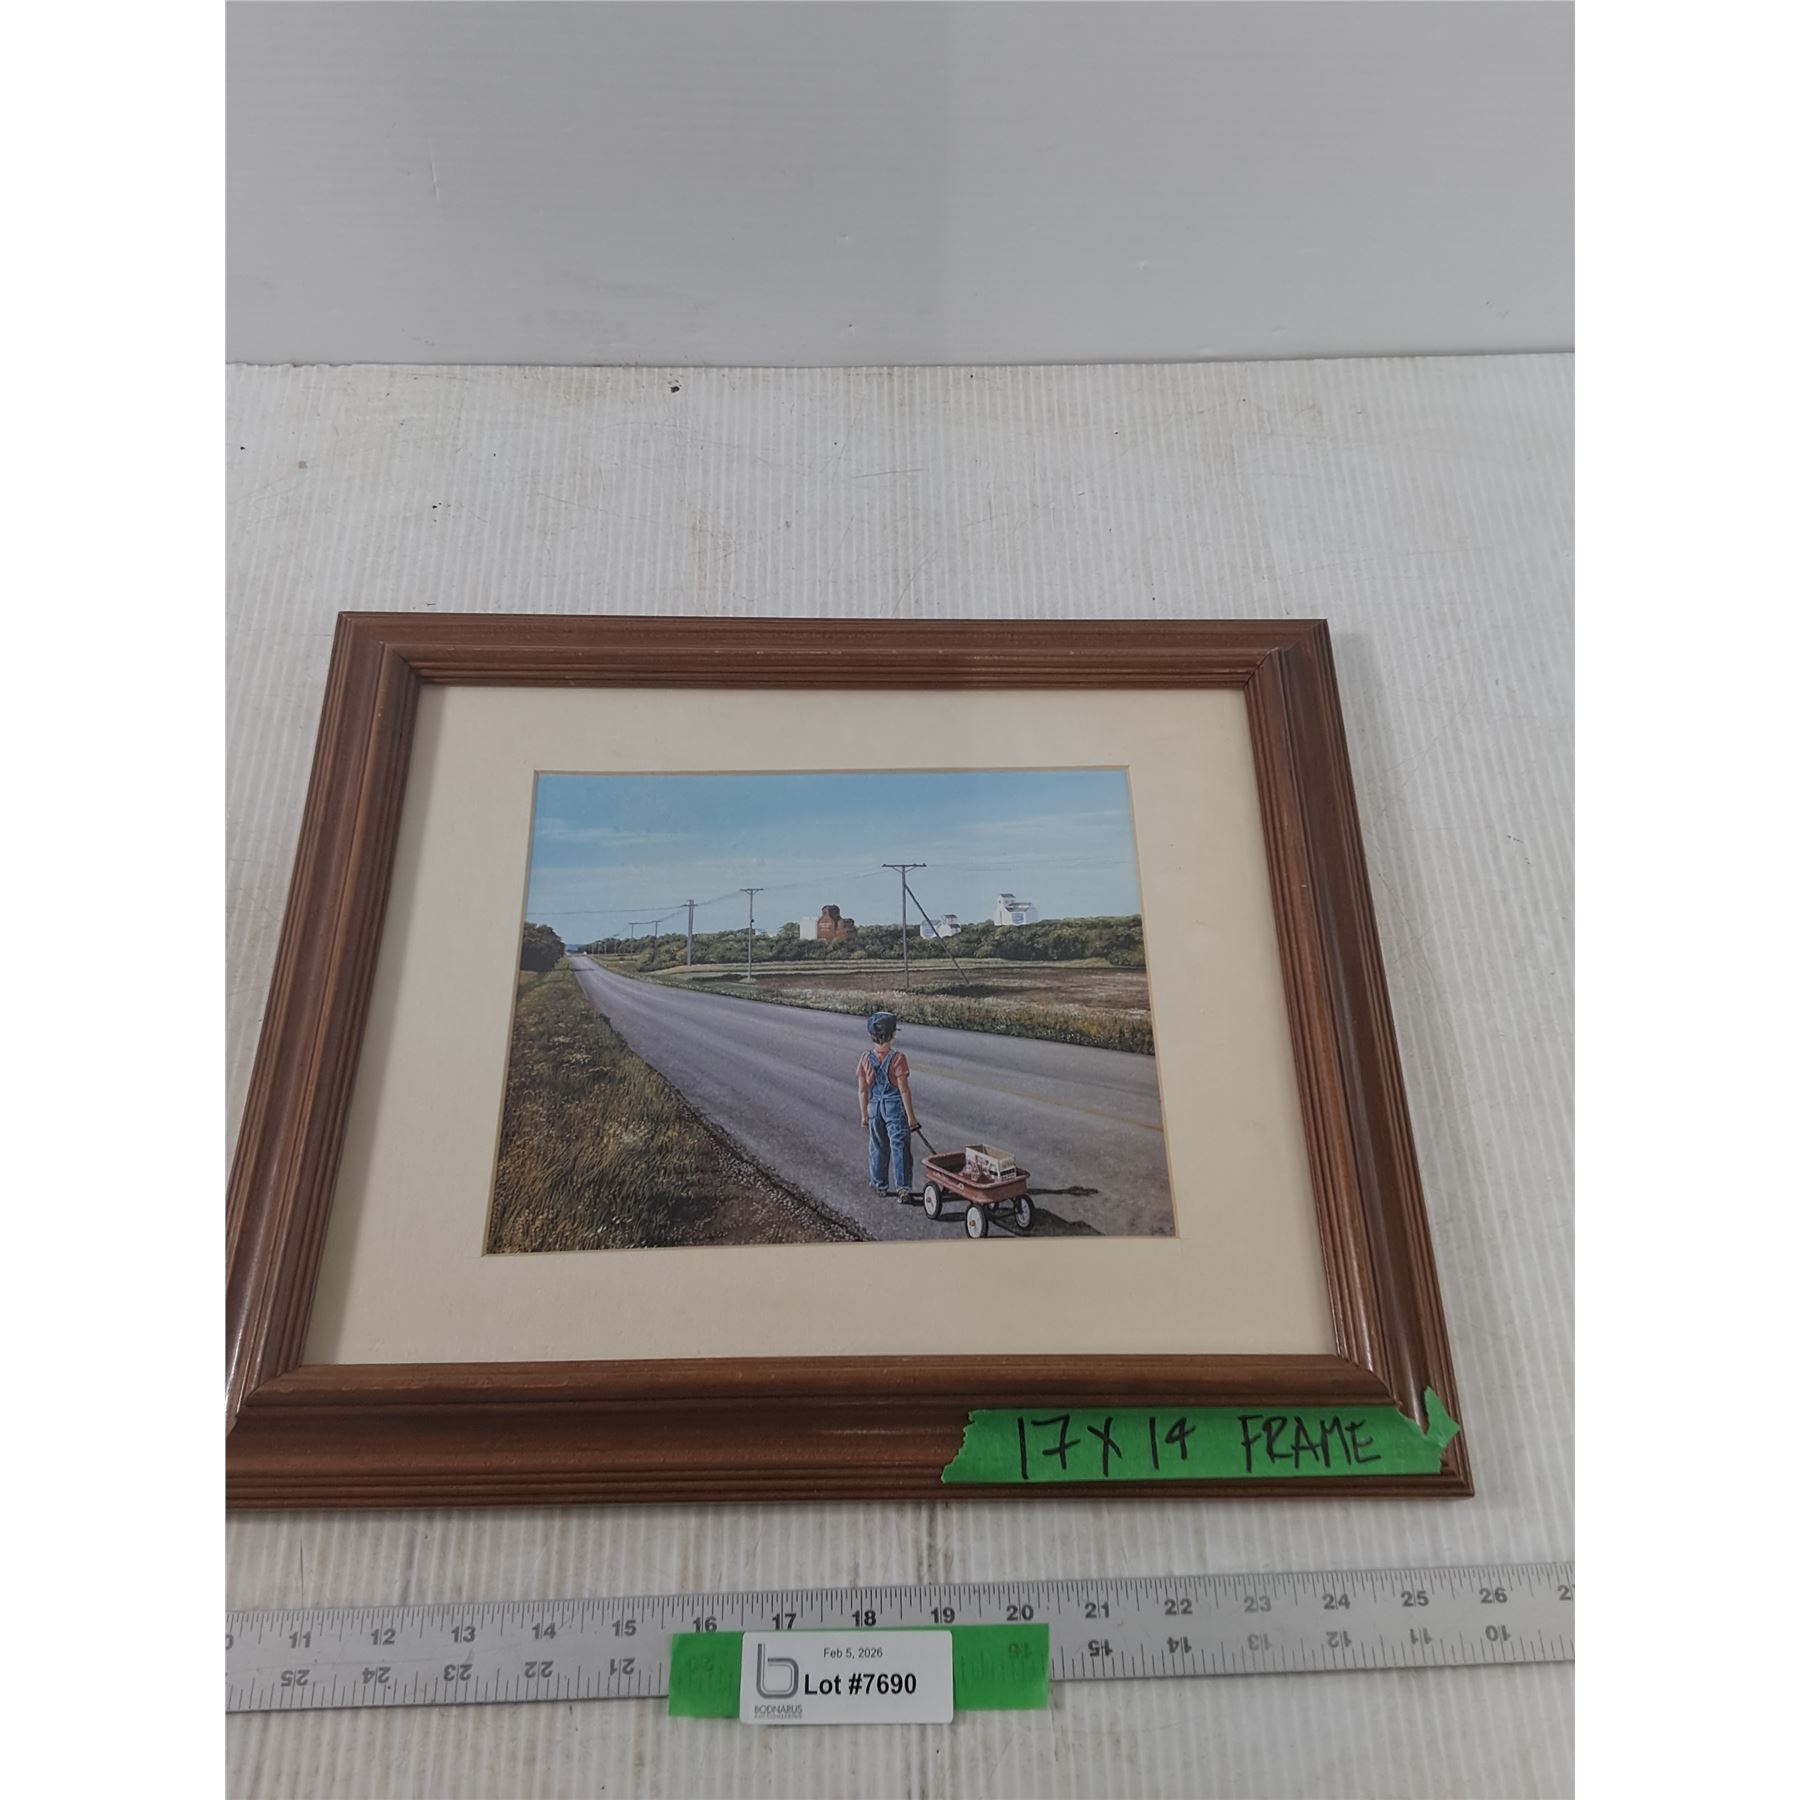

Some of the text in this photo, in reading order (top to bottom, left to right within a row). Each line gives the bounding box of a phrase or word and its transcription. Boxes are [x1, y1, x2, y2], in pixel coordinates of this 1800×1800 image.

[1016, 1415, 1081, 1480] 17
[1149, 1416, 1198, 1470] 14
[1238, 1413, 1382, 1473] FRAME
[289, 1631, 311, 1648] 11
[371, 1629, 396, 1646] 12
[451, 1626, 476, 1643] 13
[532, 1623, 556, 1640] 14
[612, 1620, 637, 1637] 15
[693, 1616, 717, 1633] 16
[772, 1613, 796, 1630] 17
[851, 1610, 877, 1628] 18
[930, 1607, 956, 1624] 19
[1006, 1604, 1034, 1621] 20
[1085, 1602, 1111, 1619] 21
[1164, 1598, 1193, 1616] 22
[1243, 1596, 1272, 1613] 23
[1322, 1593, 1351, 1610] 24
[1401, 1590, 1429, 1607] 25
[1479, 1587, 1508, 1605] 26
[1557, 1584, 1575, 1601] 2
[1247, 1633, 1272, 1651] 13
[1326, 1630, 1352, 1648] 12
[1409, 1627, 1432, 1645] 11
[1485, 1624, 1511, 1642] 10
[823, 1647, 883, 1660] Feb 5, 2026
[1088, 1639, 1113, 1657] 15
[1167, 1636, 1192, 1654] 14
[362, 1667, 391, 1684] 24
[443, 1664, 472, 1681] 23
[525, 1661, 554, 1678] 22
[609, 1658, 635, 1676] 21
[281, 1669, 311, 1687] 25
[804, 1672, 917, 1695] Lot #7690
